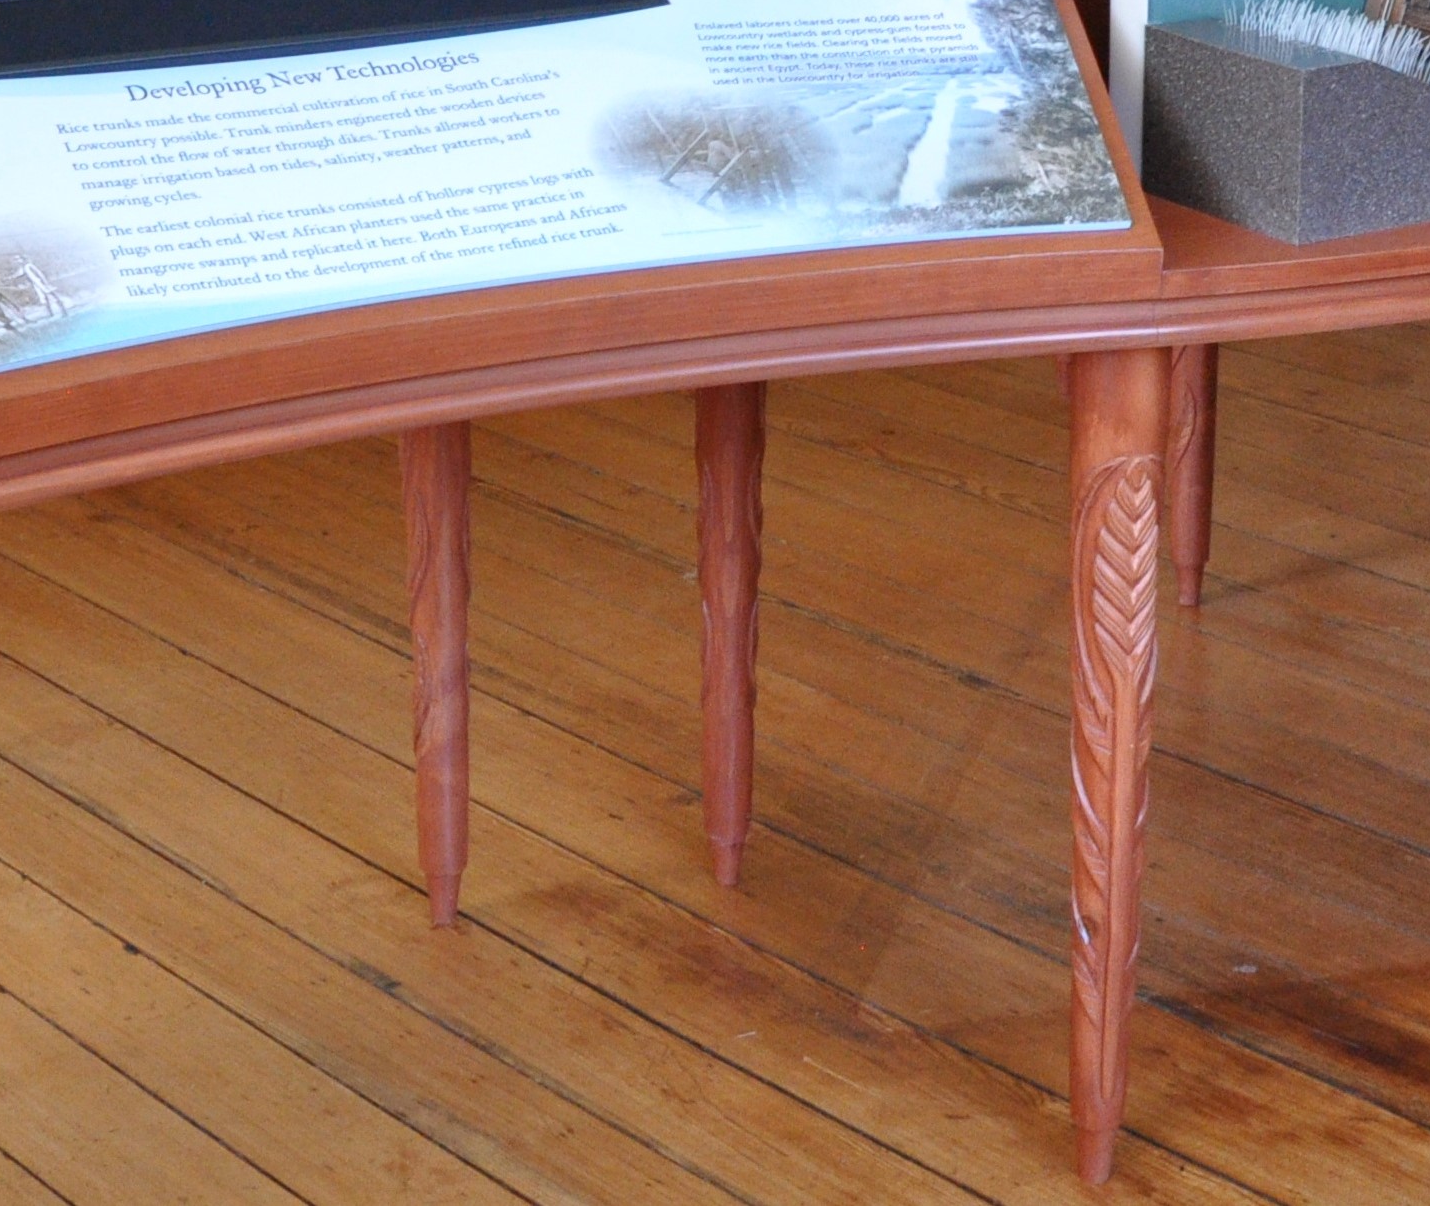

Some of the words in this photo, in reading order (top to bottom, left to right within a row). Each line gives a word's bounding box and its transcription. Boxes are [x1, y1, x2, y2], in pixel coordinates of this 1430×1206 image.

[56, 124, 89, 134] Rice
[93, 119, 142, 131] trunks
[145, 114, 184, 127] made
[187, 113, 211, 123] the
[215, 102, 300, 120] commercial
[303, 97, 379, 111] cultivation
[382, 91, 396, 102] of
[400, 91, 425, 100] rice
[429, 88, 443, 96] in
[445, 80, 489, 93] South
[491, 70, 560, 87] Carolina’s
[125, 77, 267, 101] Developing
[267, 70, 322, 87] New
[326, 52, 480, 81] Technologies
